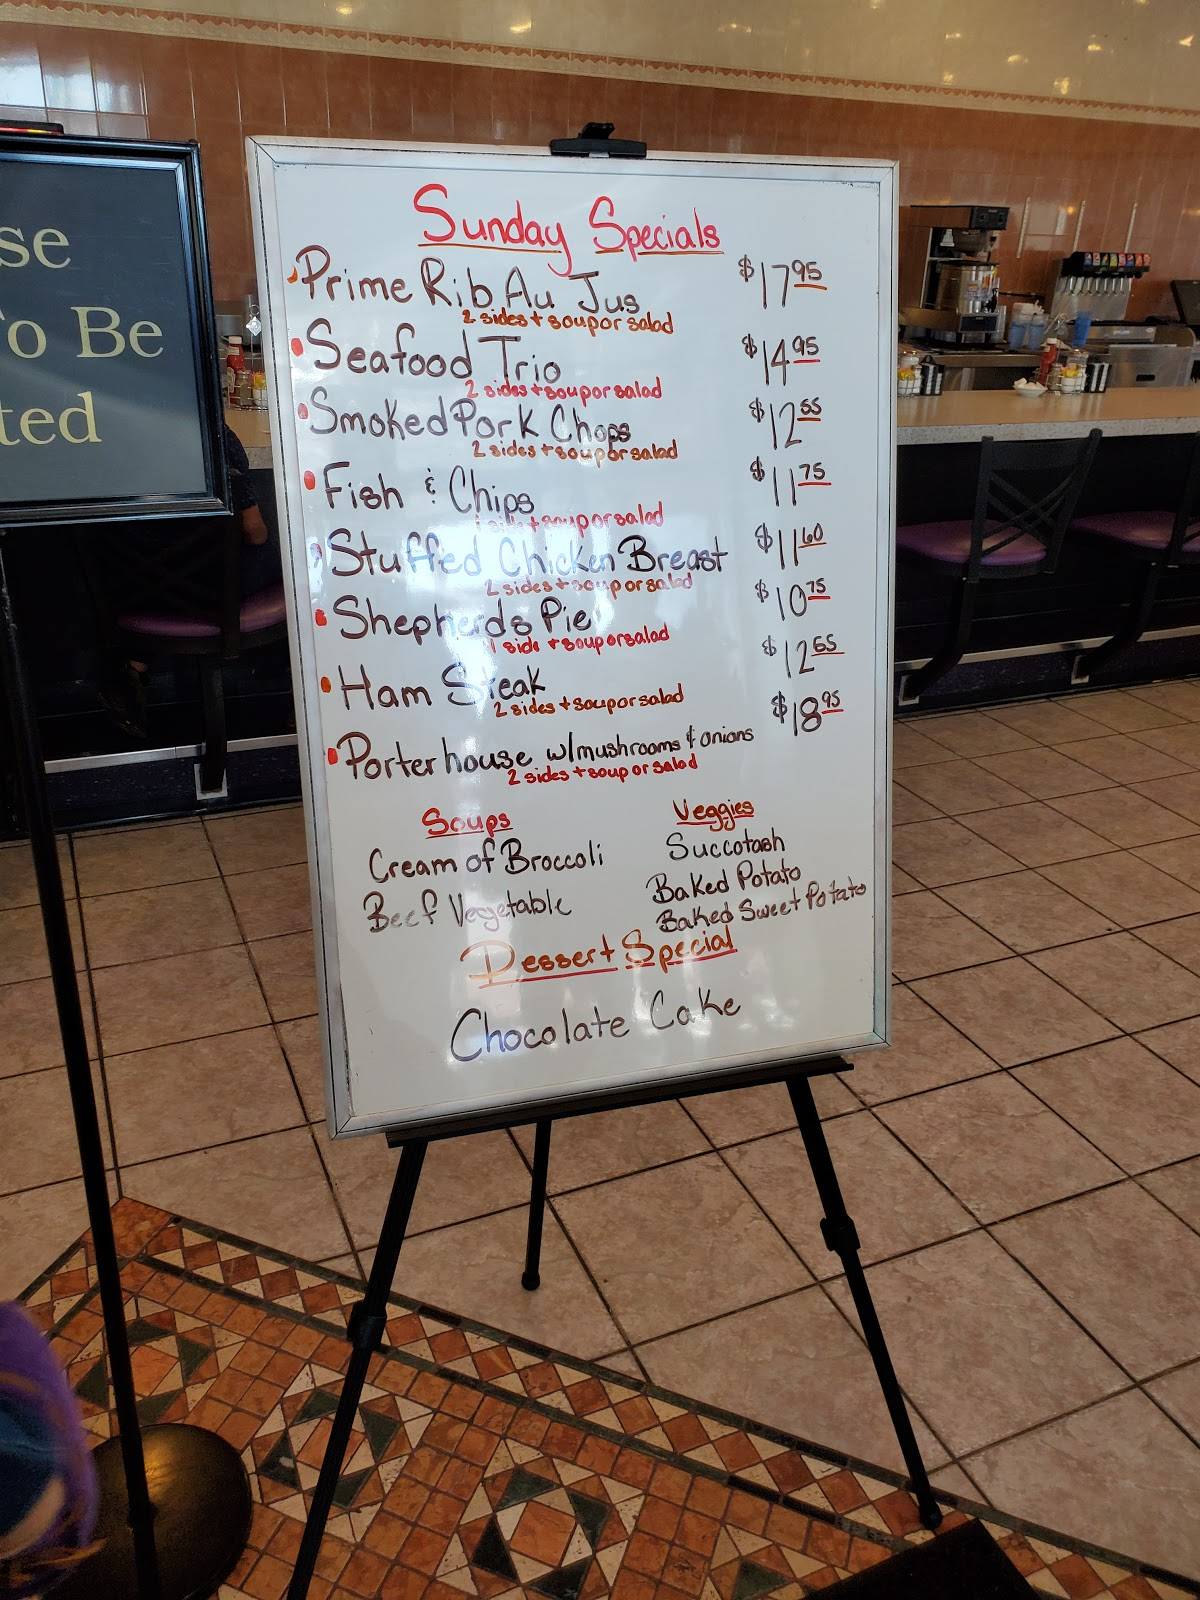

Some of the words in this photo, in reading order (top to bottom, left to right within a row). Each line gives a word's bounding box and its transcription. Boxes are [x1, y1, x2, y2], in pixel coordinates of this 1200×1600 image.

[0, 227, 71, 269] se
[413, 183, 573, 277] Sunday
[588, 195, 721, 262] Specials
[296, 244, 413, 303] Prime
[420, 257, 493, 308] Rib
[505, 266, 555, 308] Au
[569, 271, 640, 314] Jus
[0, 308, 47, 358] o
[71, 307, 164, 358] Be
[462, 309, 476, 324] 2
[480, 306, 529, 327] sides
[627, 311, 674, 335] salad
[307, 318, 472, 379] Seafood
[478, 335, 561, 383] Trio
[464, 379, 479, 399] 2
[483, 380, 528, 398] sides
[613, 376, 662, 400] salad
[310, 386, 449, 440] Smoked
[450, 398, 539, 438] Pork
[550, 403, 631, 450] Chops
[472, 440, 486, 458] 2
[489, 440, 536, 459] sides
[630, 438, 678, 460] salad
[324, 461, 404, 510] Fish
[450, 465, 535, 525] Chips
[613, 500, 664, 527] salad
[327, 528, 482, 576] Stuffed
[500, 534, 616, 576] Chicken
[617, 534, 728, 572] Breast
[485, 578, 499, 596] 2
[502, 575, 553, 596] sides
[646, 572, 693, 593] salad
[333, 594, 533, 645] Shepherds
[541, 596, 592, 633] Pie
[624, 622, 670, 648] salad
[338, 664, 432, 710] Ham
[493, 701, 508, 718] 2
[511, 697, 556, 716] sides
[639, 683, 685, 706] salad
[700, 725, 755, 748] onions
[507, 768, 520, 785] 2
[524, 766, 570, 784] sides
[653, 752, 698, 774] salad
[421, 807, 511, 837] Soups
[673, 799, 755, 831] Veggies
[369, 848, 457, 883] Cream
[465, 837, 496, 873] of
[500, 837, 604, 874] Broccoli
[666, 826, 786, 861] Succotash
[645, 868, 730, 904] Baked
[736, 858, 802, 890] Potato
[363, 888, 438, 933] Beef
[449, 888, 572, 932] Vegetable
[656, 901, 734, 933] Baked
[738, 887, 801, 922] Sweet
[805, 875, 867, 910] Potato
[459, 933, 615, 986] Dessert
[621, 924, 735, 974] Special
[450, 1006, 630, 1062] Chocolate
[650, 986, 741, 1030] Cake
